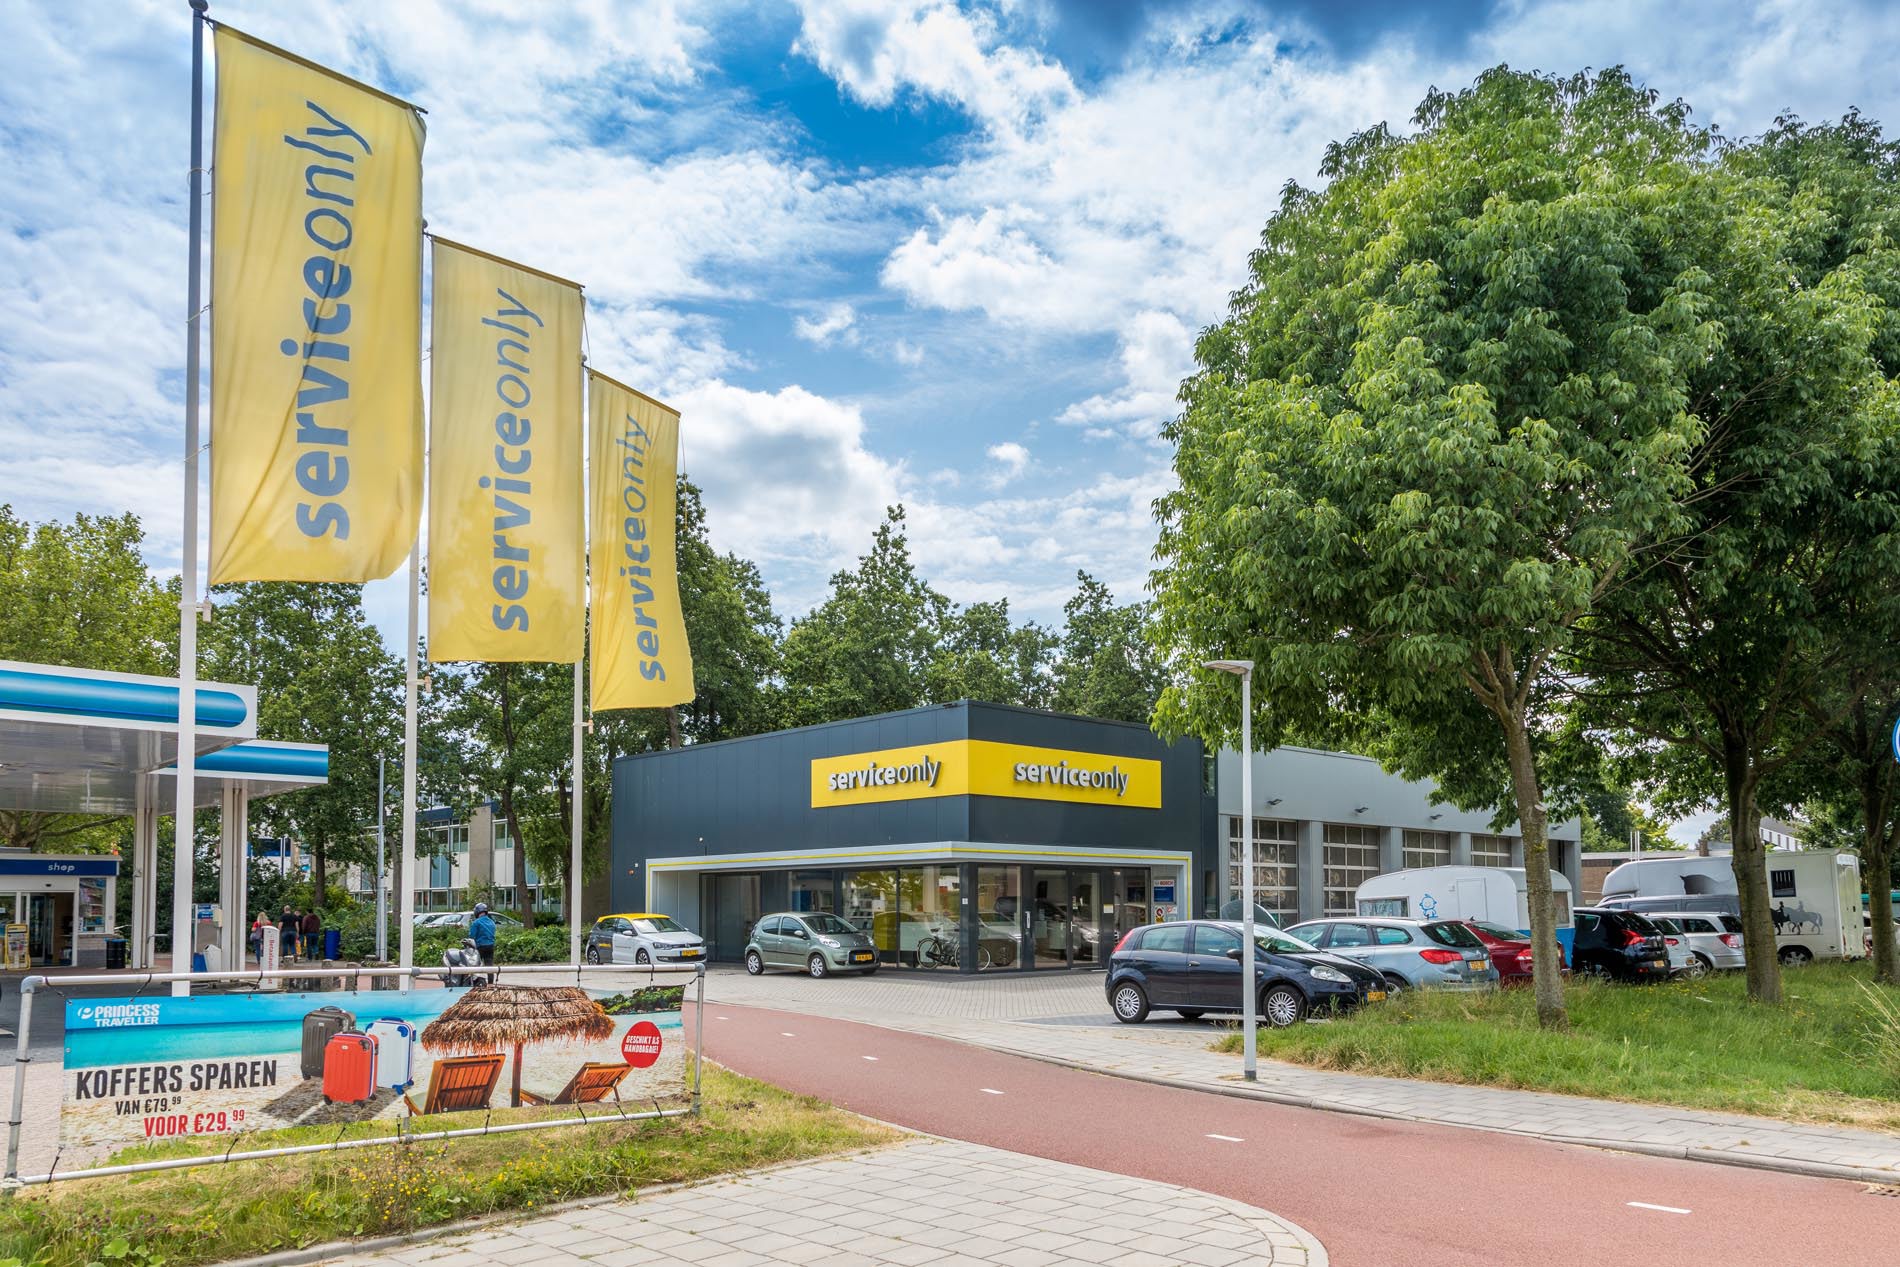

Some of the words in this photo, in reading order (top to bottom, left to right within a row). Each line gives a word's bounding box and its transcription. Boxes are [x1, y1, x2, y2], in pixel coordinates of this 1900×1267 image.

[281, 100, 372, 541] serviceonly
[479, 288, 544, 632] serviceonly
[616, 413, 665, 682] serviceonly
[828, 755, 941, 791] serviceonly
[1014, 760, 1129, 796] serviceonly
[48, 862, 75, 872] shop
[94, 1003, 161, 1019] PRINCESS
[94, 1016, 159, 1027] TRAVELLER
[76, 1065, 183, 1100] KOFFERS
[190, 1060, 277, 1091] SPAREN
[116, 1100, 140, 1115] VAN
[143, 1114, 188, 1137] VOOR
